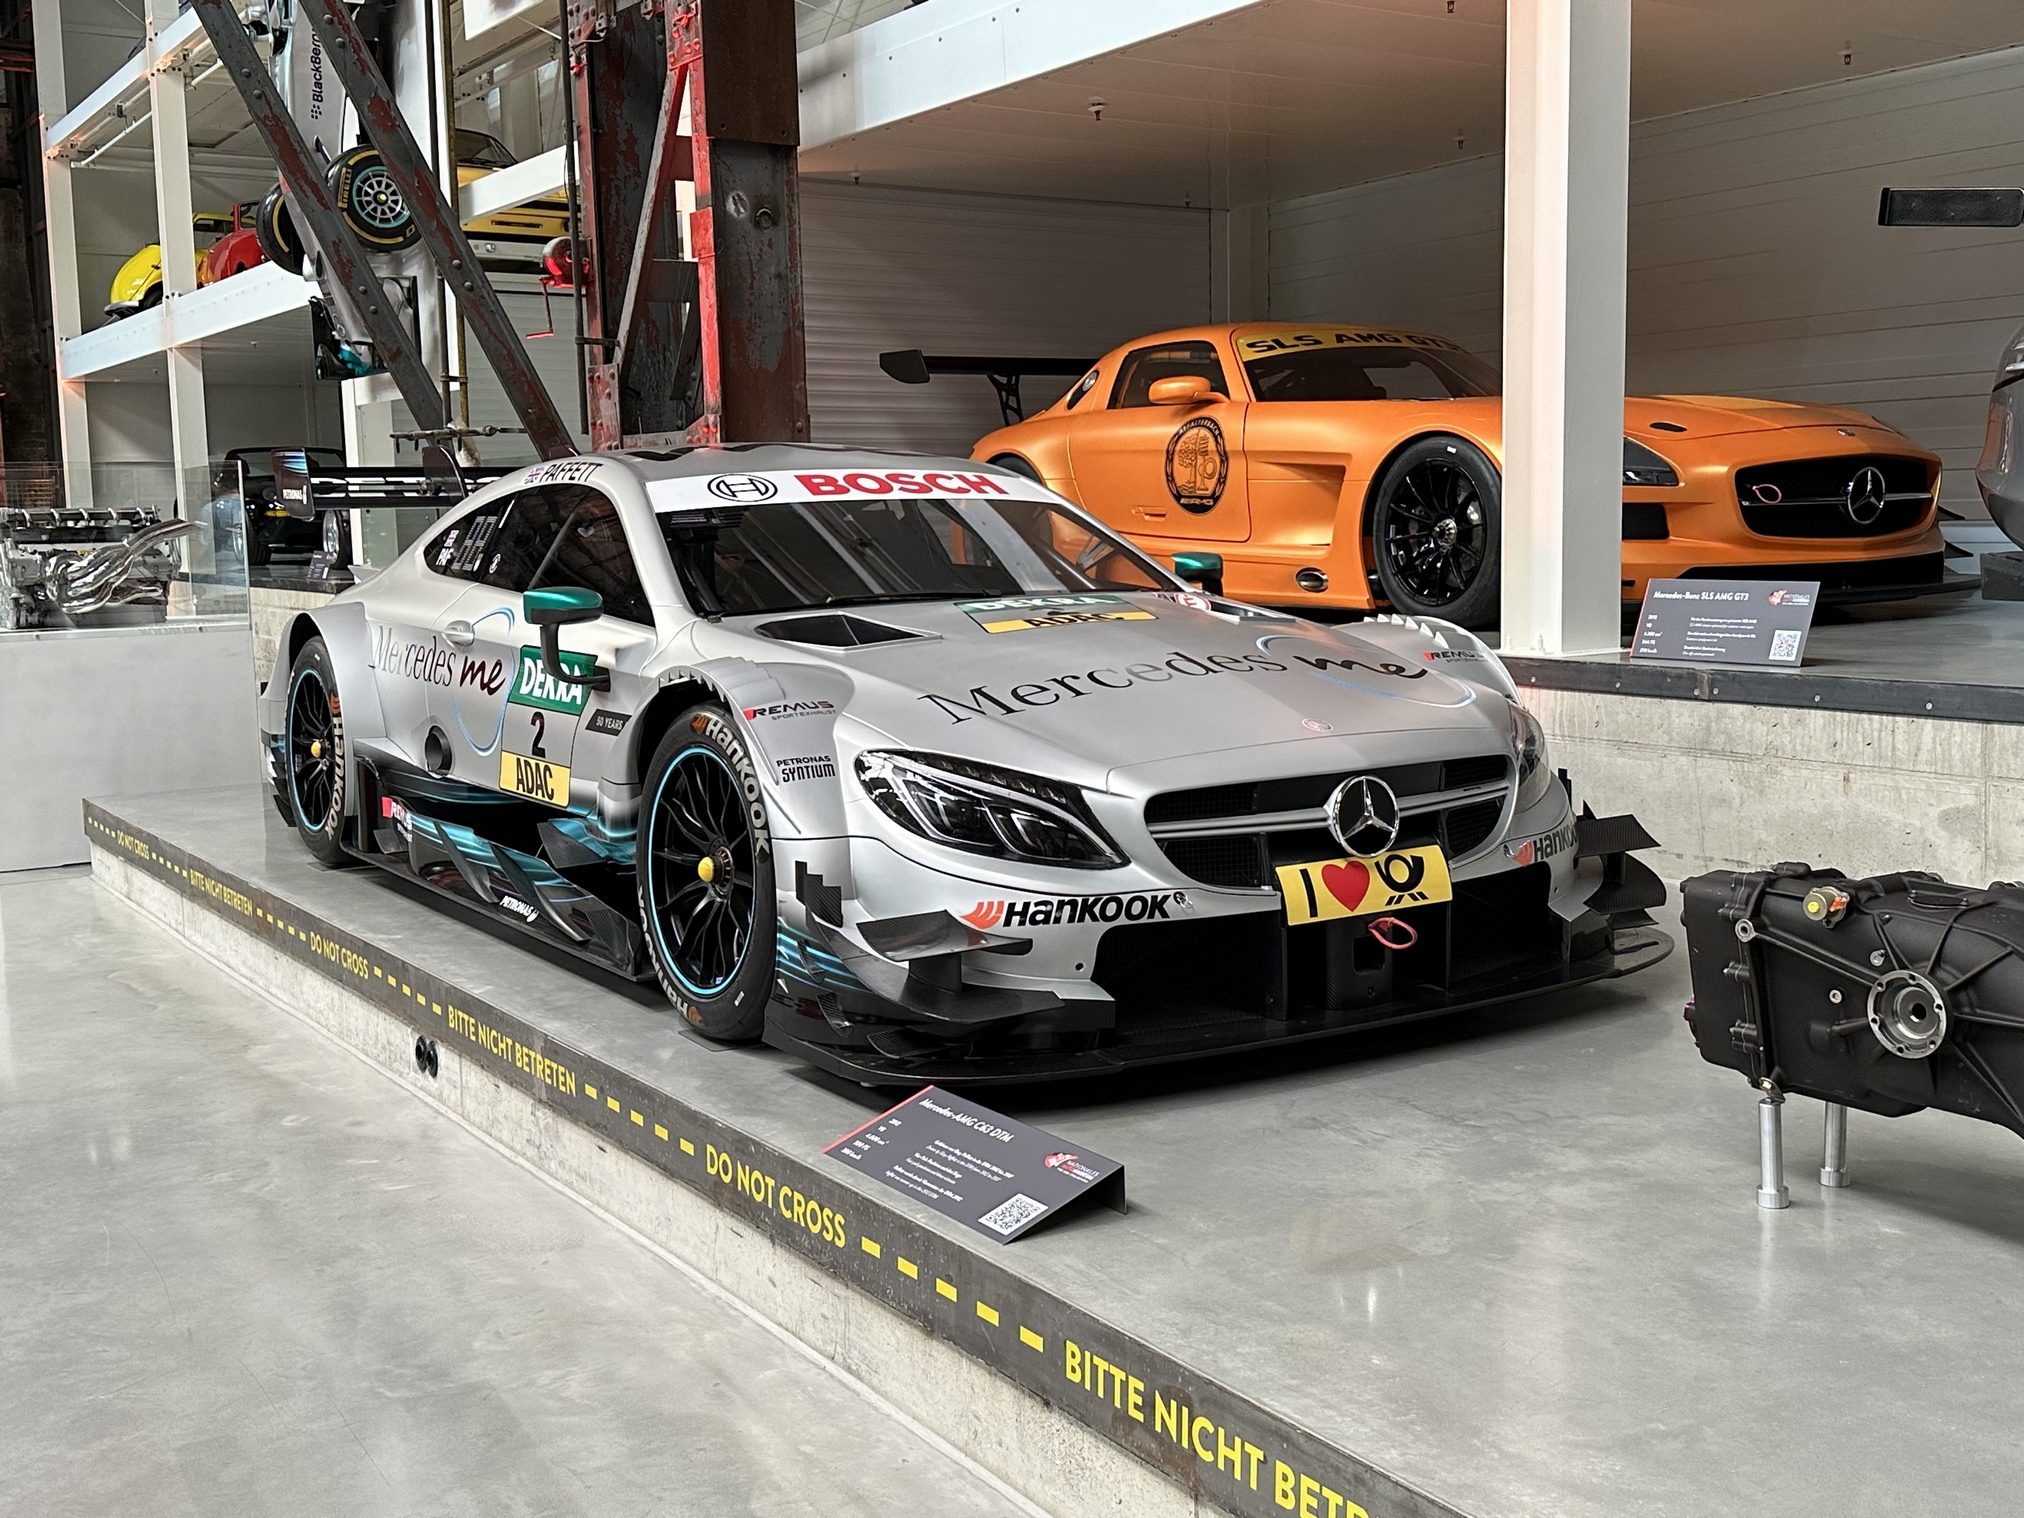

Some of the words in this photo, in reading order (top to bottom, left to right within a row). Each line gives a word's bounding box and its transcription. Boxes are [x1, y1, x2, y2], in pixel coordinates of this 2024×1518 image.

[310, 27, 324, 103] BlackBerr
[1246, 334, 1323, 353] SLS
[1334, 333, 1401, 344] AMG
[538, 462, 604, 483] PAFFETT
[794, 473, 1010, 496] BOSCH
[972, 596, 1117, 610] DEKRA
[1653, 591, 1700, 600] Mercedes-Benz
[1701, 591, 1714, 600] SLS
[1715, 592, 1733, 601] AMG
[1734, 593, 1749, 601] GT3
[1023, 613, 1123, 627] ADAC
[368, 626, 456, 687] Mercedes
[459, 655, 506, 696] me
[519, 656, 584, 705] DEKRA
[754, 701, 834, 719] REMUS
[917, 652, 1288, 724] Mercedes
[1294, 655, 1428, 679] me
[531, 711, 546, 758] 2
[604, 717, 623, 730] YEARS
[515, 757, 555, 801] ADAC
[776, 756, 832, 767] PETRONAS
[782, 764, 836, 783] SYNTIUM
[134, 839, 150, 861] CROSS
[190, 868, 205, 891] BITTE
[205, 876, 223, 901] NICHT
[222, 885, 253, 918] BETRETEN
[499, 895, 534, 917] PETRONAS
[1299, 869, 1318, 918] I
[310, 931, 322, 955] DO
[322, 938, 340, 965] NOT
[341, 947, 369, 980] CROSS
[448, 1005, 476, 1042] BITTE
[477, 1021, 513, 1063] NICHT
[514, 1042, 577, 1098] BETRETEN
[919, 1098, 977, 1127] Mercedes-AMG
[973, 1118, 992, 1134] C63
[989, 1126, 1015, 1143] DTM
[706, 1143, 733, 1184] DO
[737, 1160, 776, 1209] NOT
[779, 1185, 846, 1249] CROSS
[1065, 1339, 1145, 1424] BITTE
[1154, 1390, 1265, 1491] NICHT
